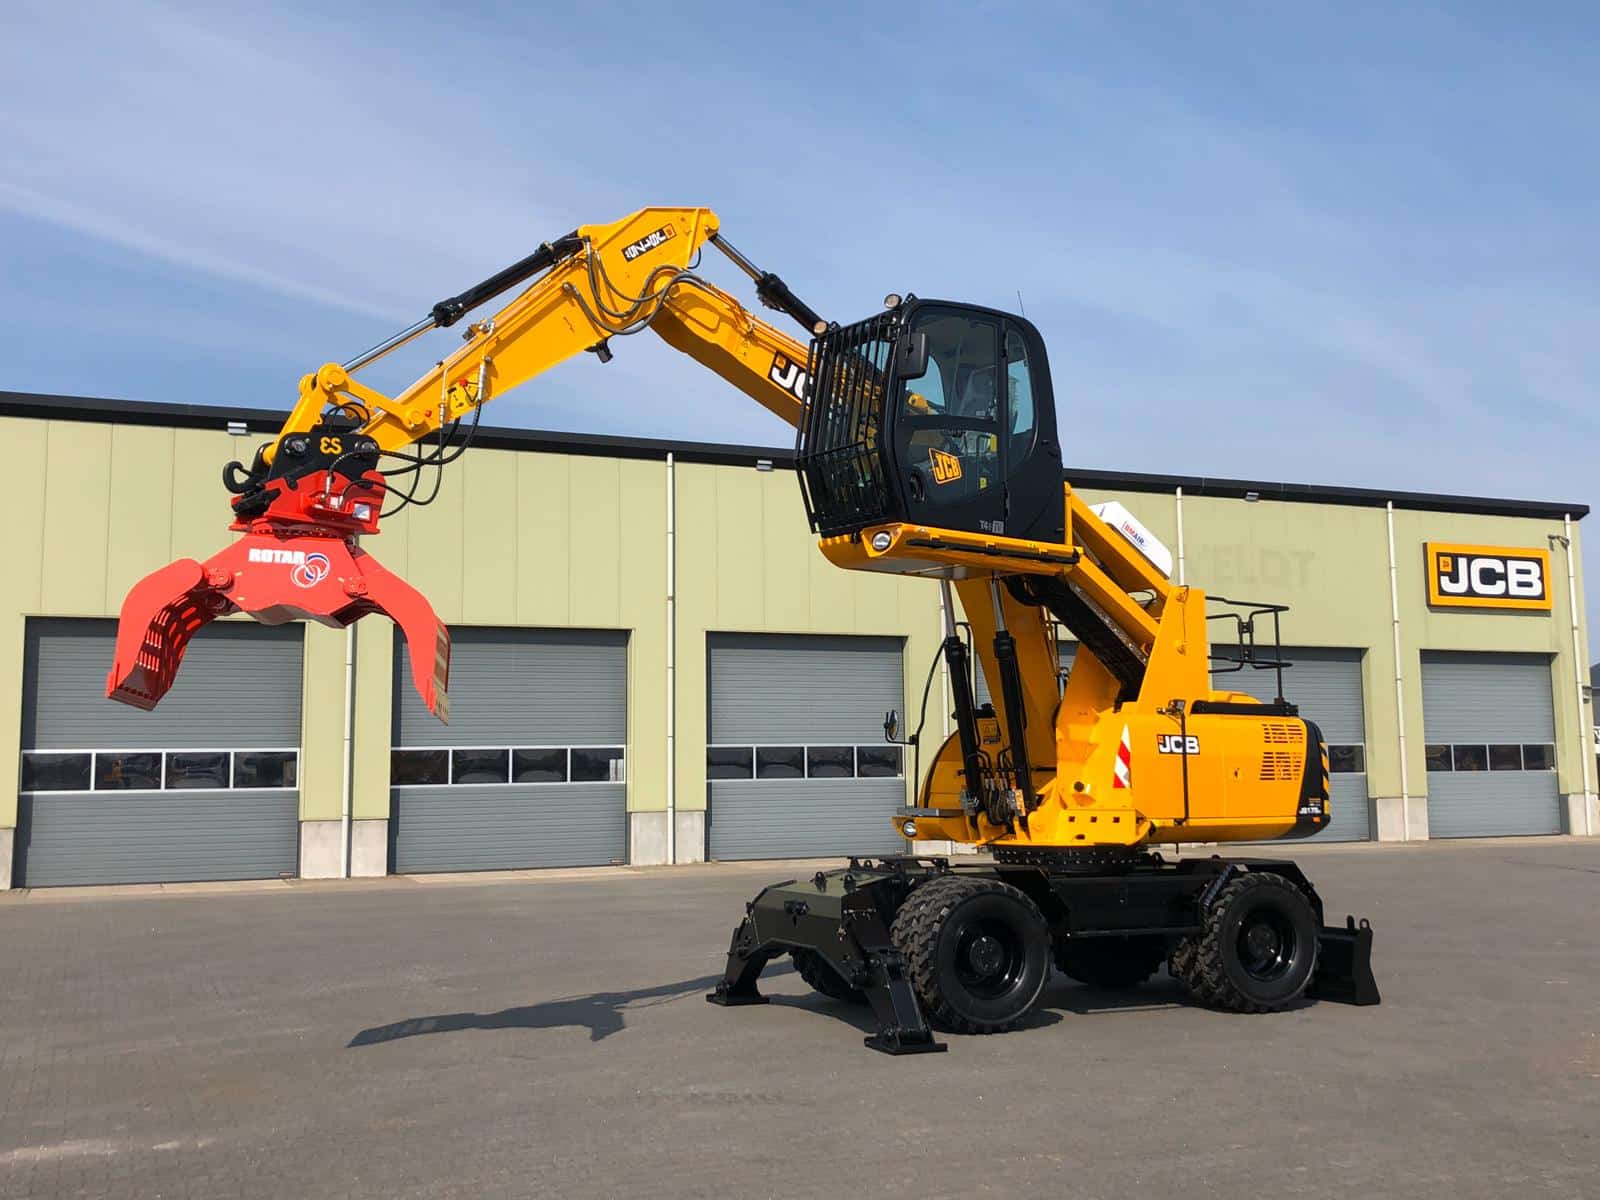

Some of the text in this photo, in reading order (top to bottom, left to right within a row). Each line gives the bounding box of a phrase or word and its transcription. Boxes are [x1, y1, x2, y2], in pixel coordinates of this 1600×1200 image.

[935, 454, 960, 480] JCB
[249, 549, 306, 565] ROTAR
[1440, 557, 1543, 596] JCB
[1159, 736, 1199, 753] JCB
